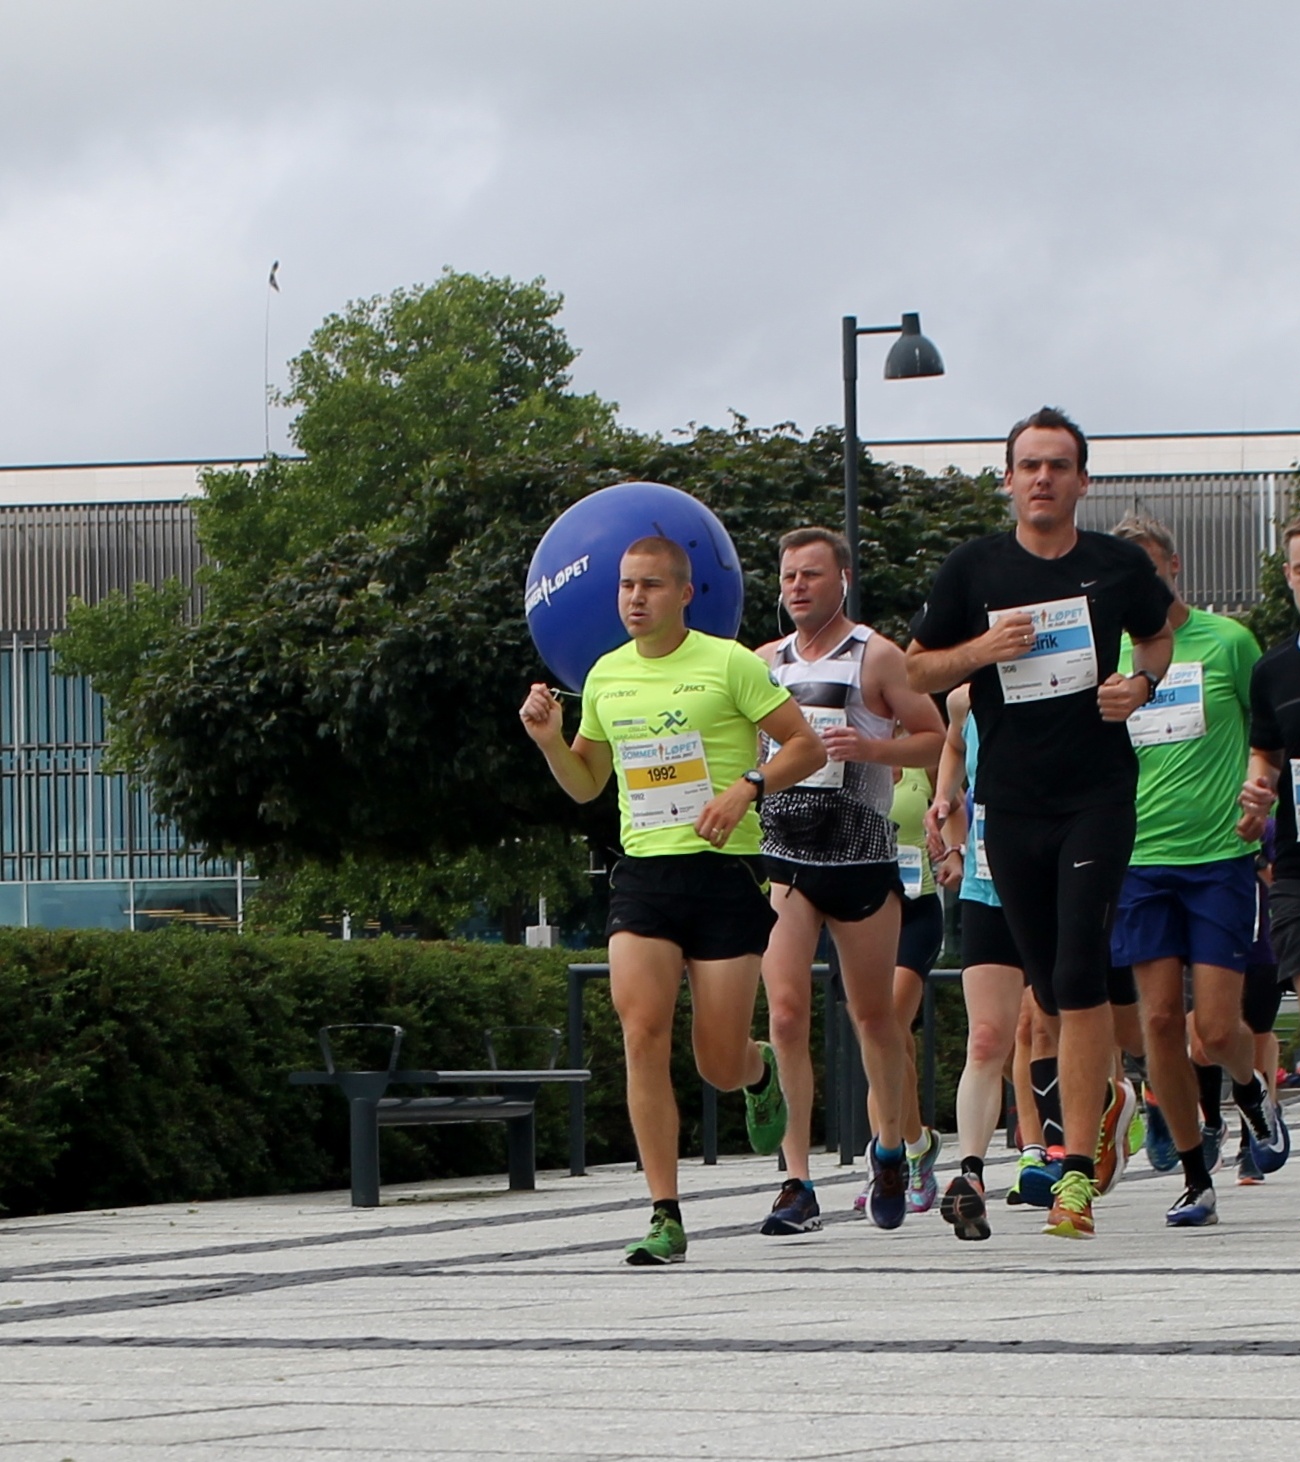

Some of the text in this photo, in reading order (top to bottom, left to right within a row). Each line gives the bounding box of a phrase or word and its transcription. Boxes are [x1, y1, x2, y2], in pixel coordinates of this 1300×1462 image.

[548, 554, 590, 595] LØPET
[1047, 608, 1084, 622] LØPET
[621, 748, 658, 761] SOMMER
[665, 741, 698, 756] LØPET
[647, 765, 678, 783] 1992
